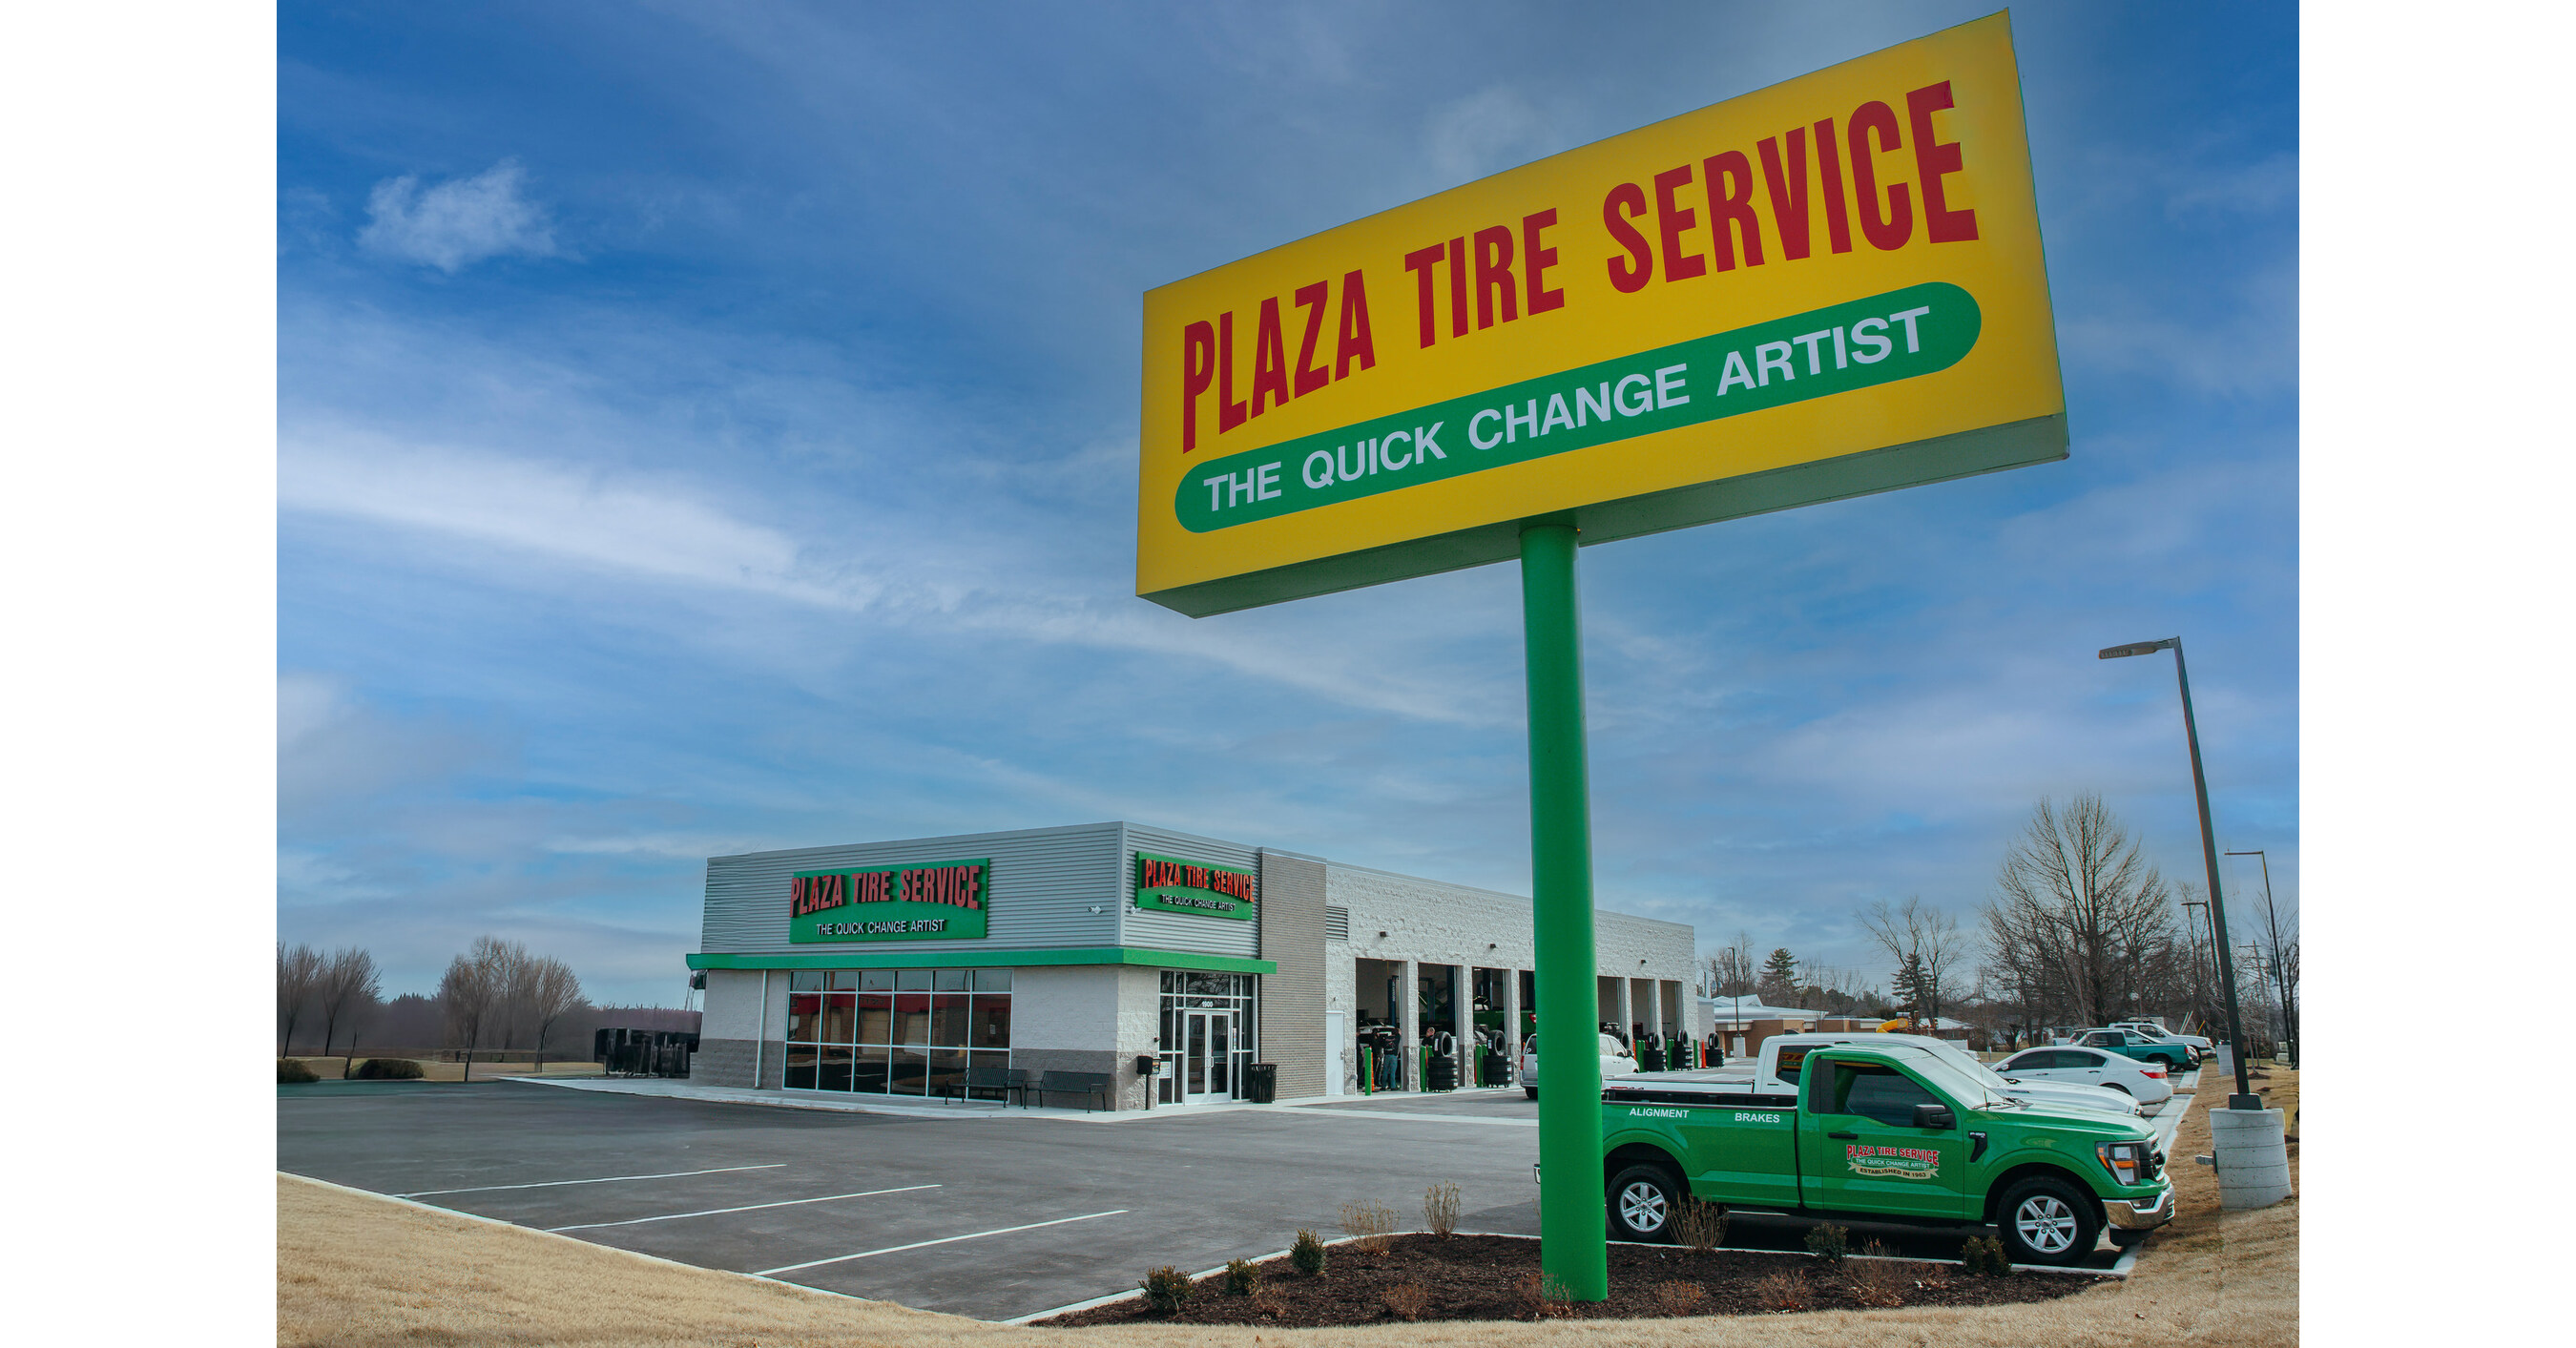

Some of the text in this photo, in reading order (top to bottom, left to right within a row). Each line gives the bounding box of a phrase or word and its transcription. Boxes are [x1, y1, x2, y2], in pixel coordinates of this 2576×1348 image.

[1183, 79, 1980, 454] PLAZA TIRE SERVICE
[1204, 306, 1931, 512] THE QUICK CHANGE ARTIST
[789, 864, 981, 918] PLAZA TIRE SERVICE
[1145, 858, 1256, 902] PLAZA TIRE SERVICE
[1161, 894, 1236, 912] THE QUICK CHANGE ARTIST
[817, 919, 945, 935] THE QUICK CHANGE ARTIST
[1629, 1108, 1780, 1124] ALIGNMENT BRAKES
[1846, 1144, 1940, 1167] PLAZA TIRE SERVICE
